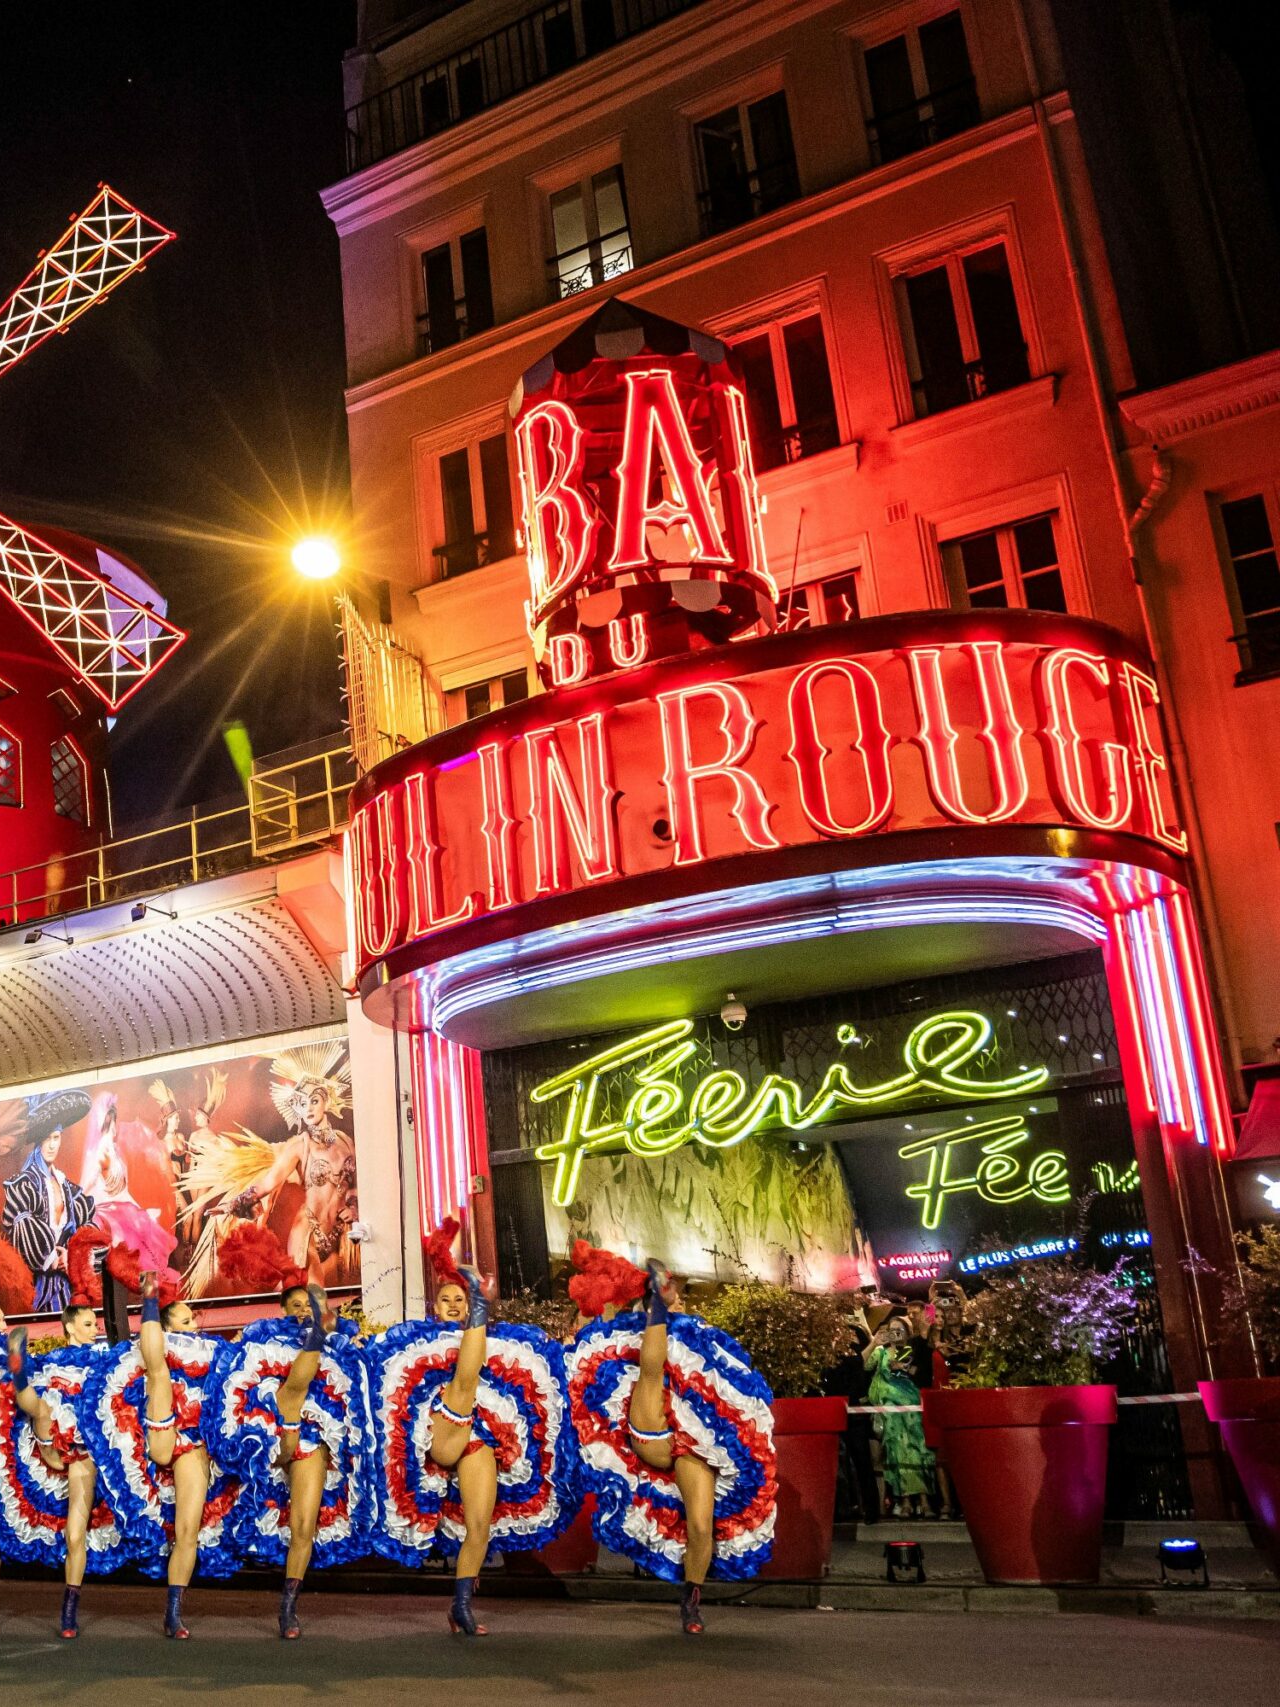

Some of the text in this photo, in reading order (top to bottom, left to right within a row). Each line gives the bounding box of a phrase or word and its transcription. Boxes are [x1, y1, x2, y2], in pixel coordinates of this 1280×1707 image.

[515, 369, 779, 613] BAL
[549, 613, 647, 686] DU
[659, 640, 1189, 867] ROUGE
[530, 1011, 1050, 1207] Féerie
